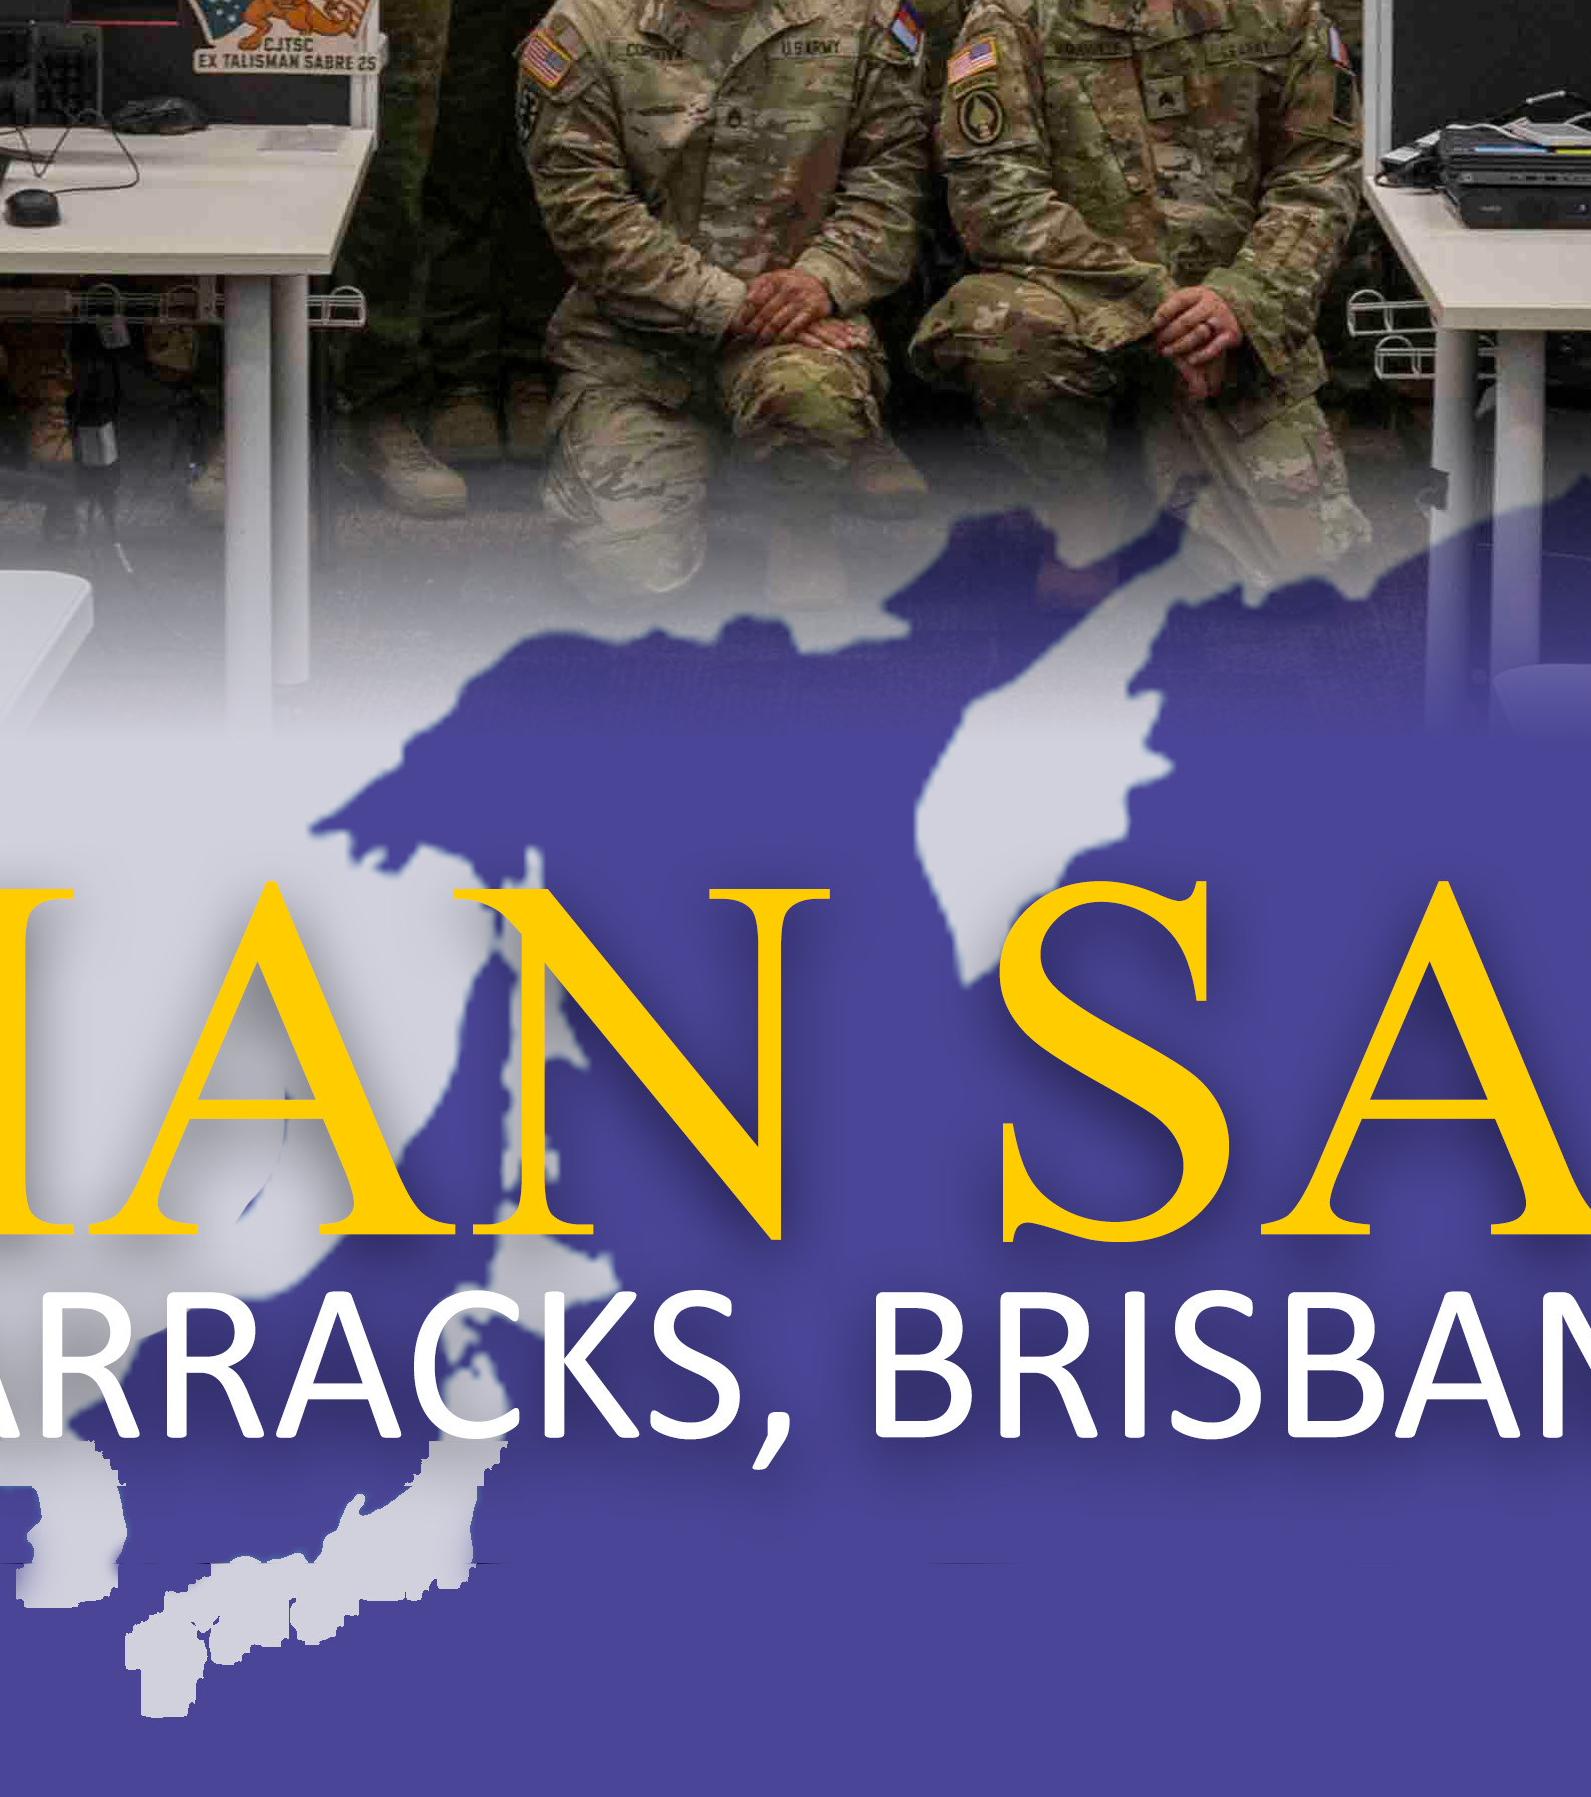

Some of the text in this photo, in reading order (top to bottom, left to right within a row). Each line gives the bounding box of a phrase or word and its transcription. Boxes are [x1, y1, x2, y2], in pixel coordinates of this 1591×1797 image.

[264, 36, 314, 52] CJTSC
[199, 54, 217, 68] EX
[223, 54, 300, 69] TALISMAN
[305, 54, 354, 70] SABRE
